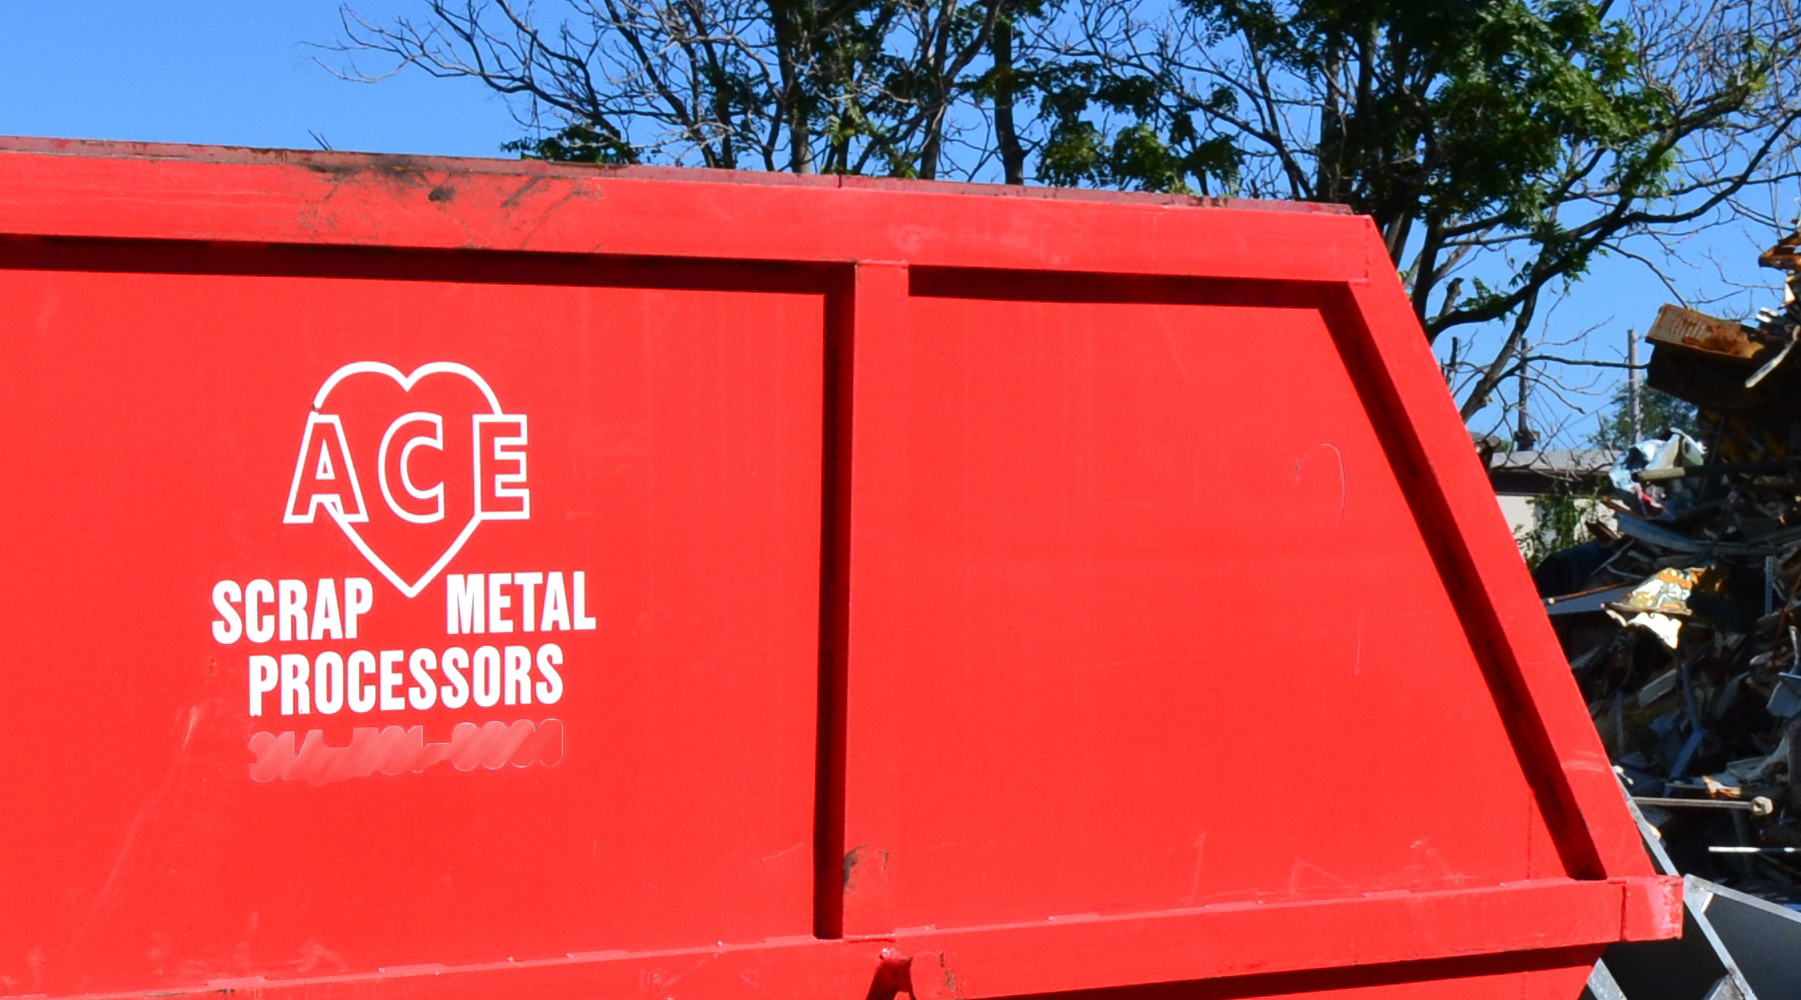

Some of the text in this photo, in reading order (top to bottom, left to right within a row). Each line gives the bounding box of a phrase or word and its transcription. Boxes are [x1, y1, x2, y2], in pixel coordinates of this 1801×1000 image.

[283, 412, 530, 524] ACE
[211, 571, 596, 644] SCRAP METAL
[249, 643, 564, 717] PROCESSORS
